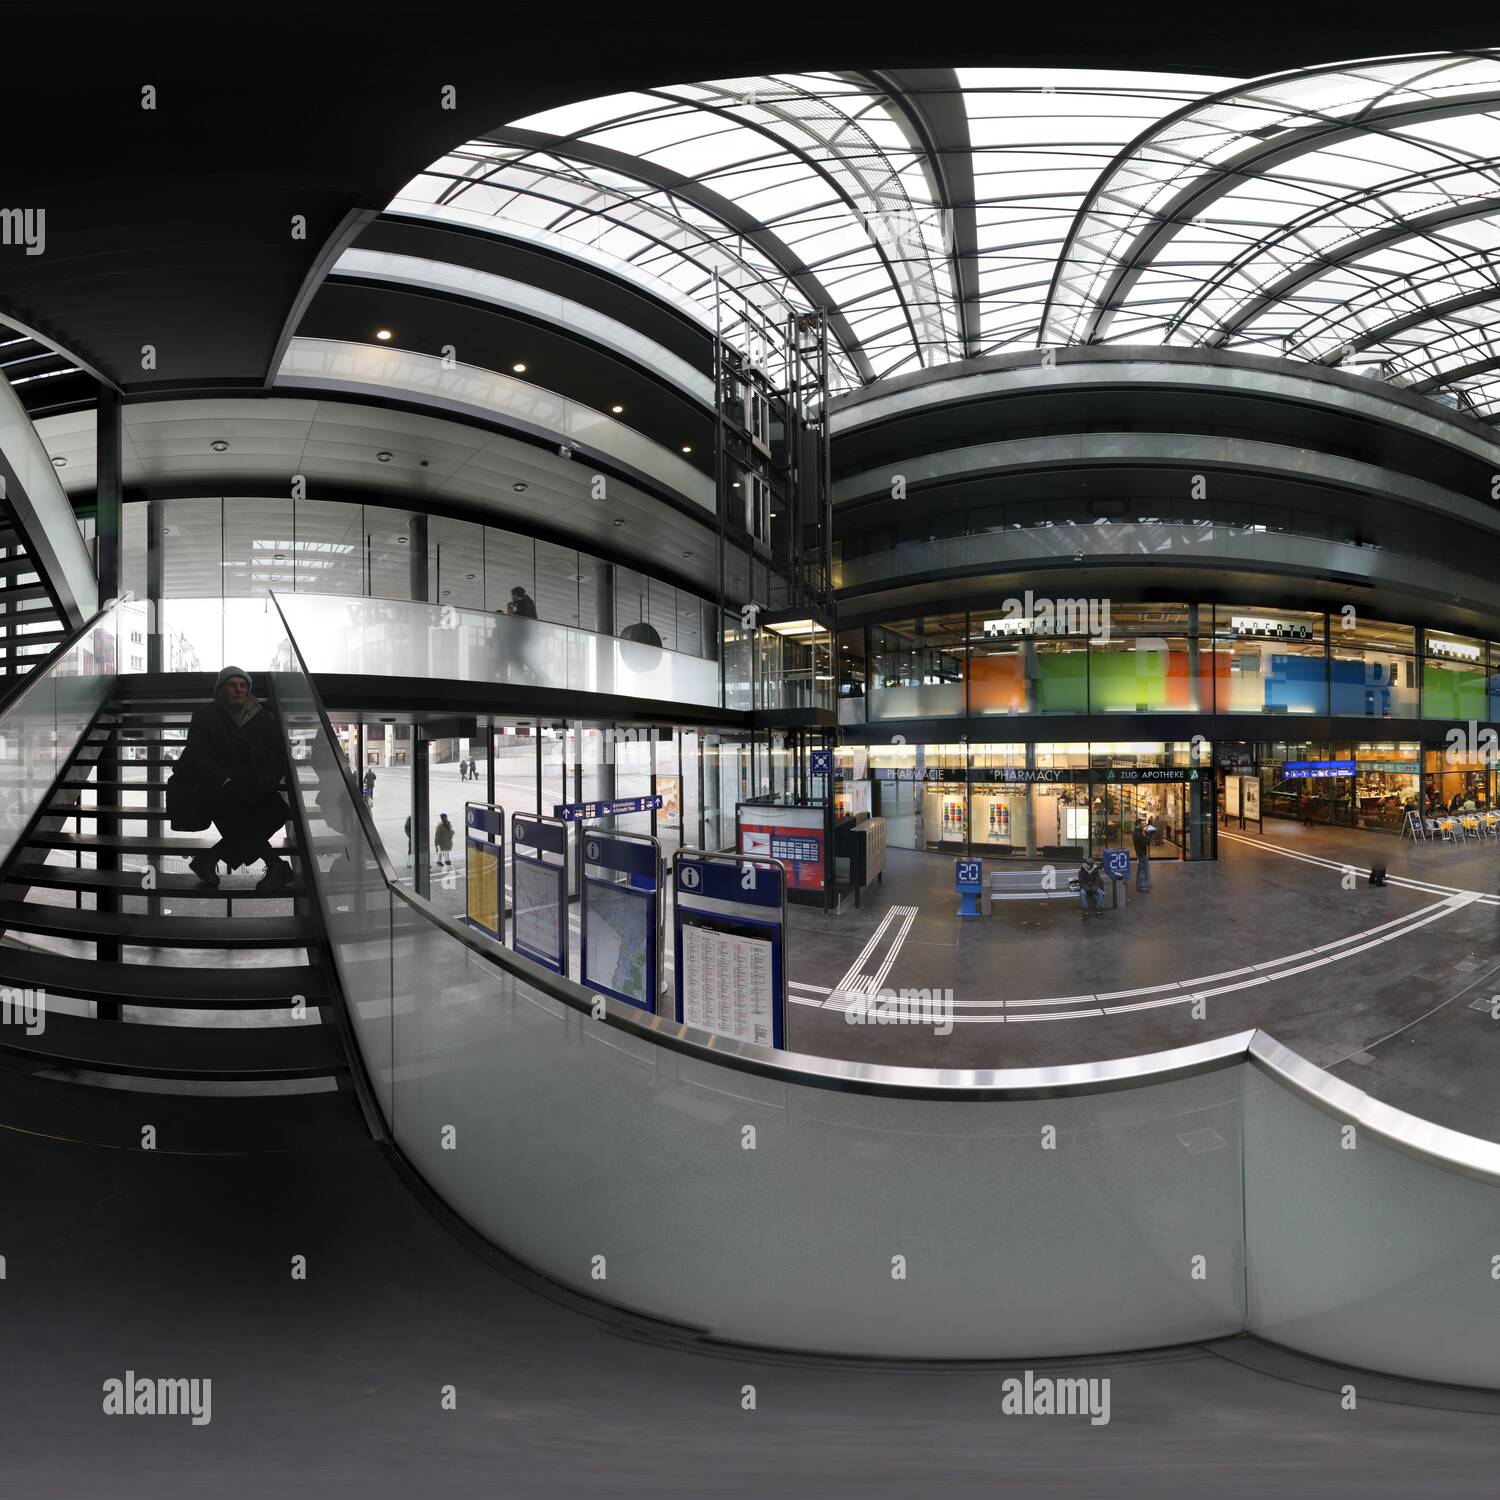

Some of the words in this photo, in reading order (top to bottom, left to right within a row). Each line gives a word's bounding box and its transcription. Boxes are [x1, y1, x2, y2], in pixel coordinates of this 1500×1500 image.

[1237, 620, 1306, 637] APERTO
[887, 769, 944, 780] PHARMACIE
[994, 769, 1061, 782] PHARMACY
[1120, 771, 1138, 779] ZUG
[1142, 770, 1184, 779] APOTHEKE
[1110, 852, 1127, 869] 20
[958, 863, 978, 880] 20
